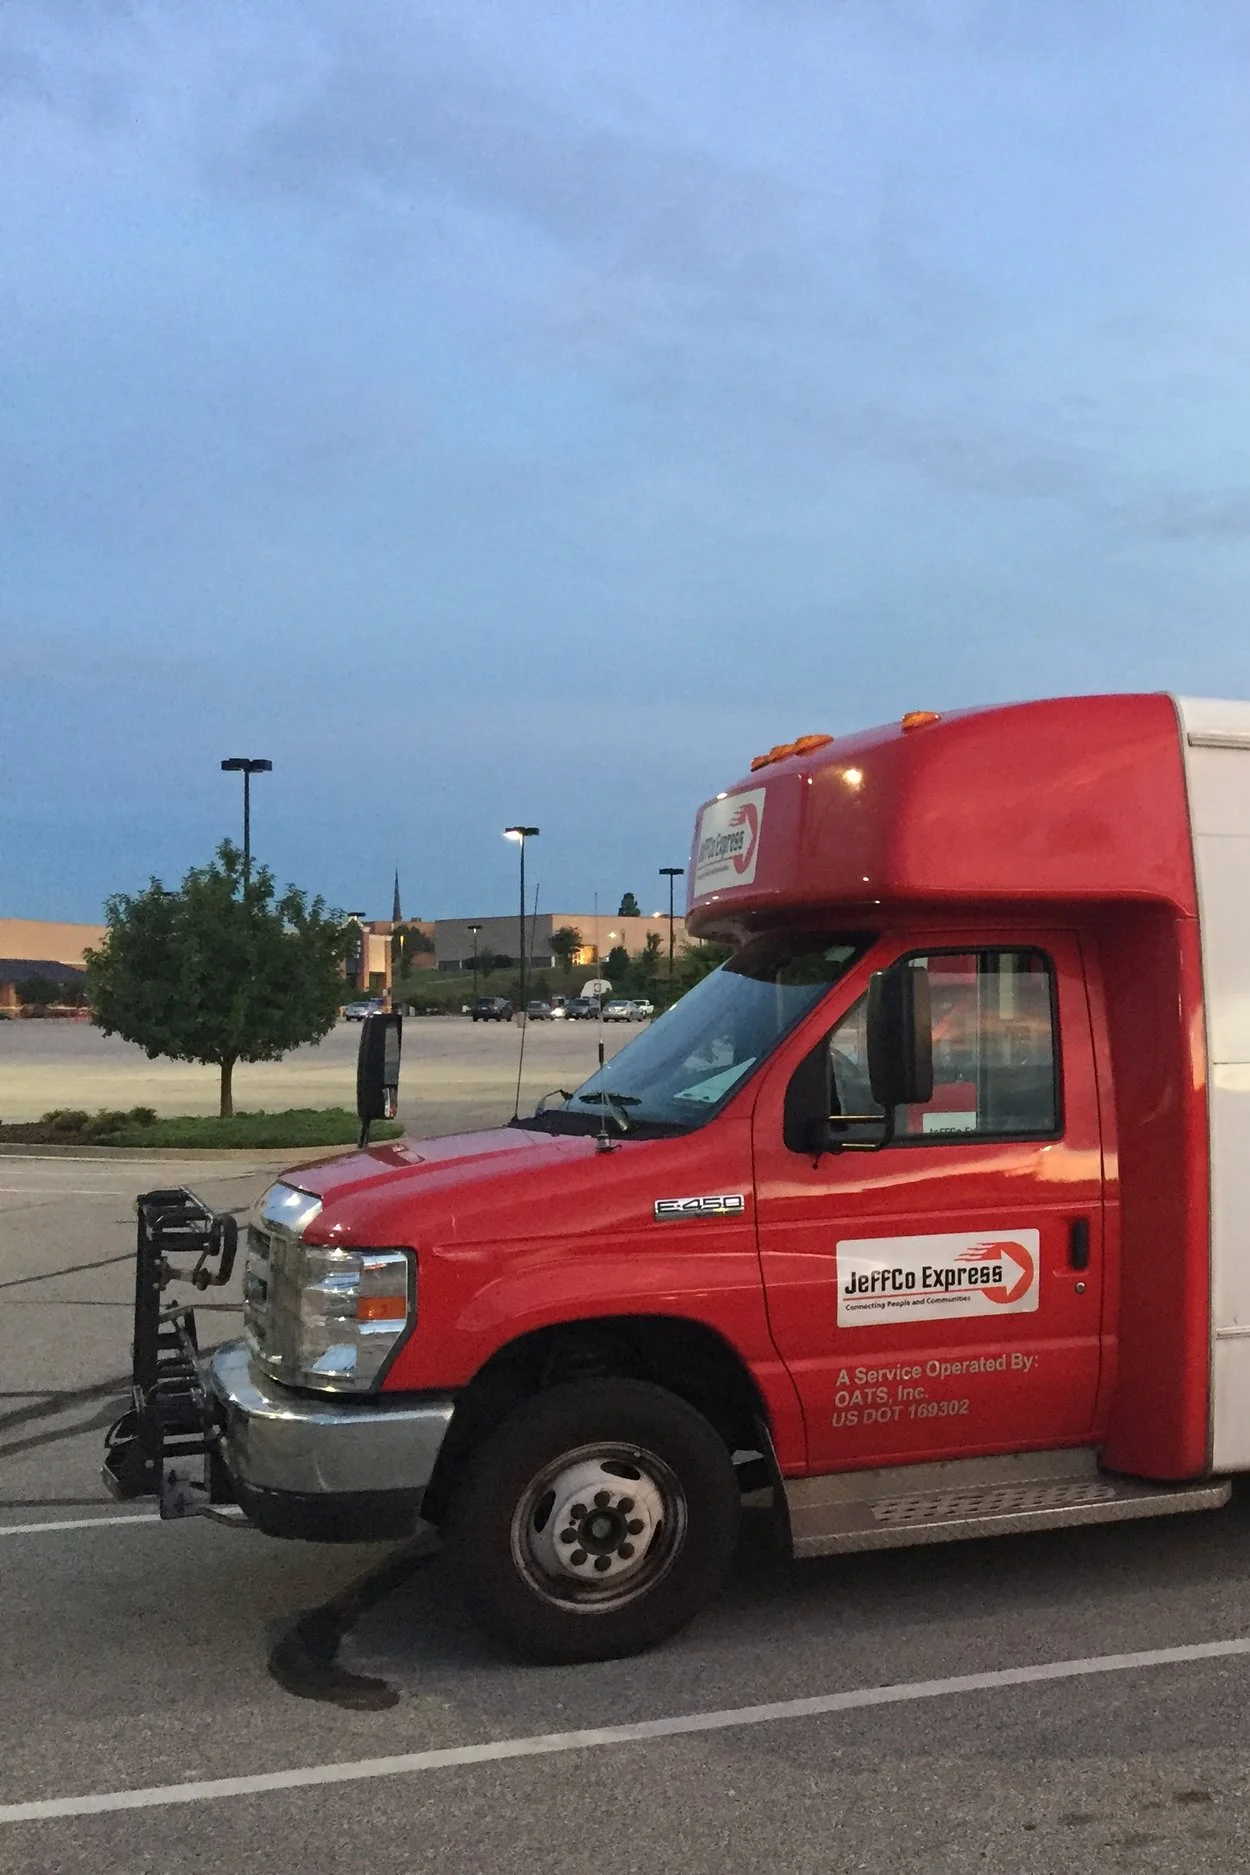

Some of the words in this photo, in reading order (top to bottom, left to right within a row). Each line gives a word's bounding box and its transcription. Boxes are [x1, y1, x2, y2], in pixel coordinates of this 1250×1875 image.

[844, 1269, 916, 1295] JeffCo
[921, 1264, 1003, 1292] Express
[845, 1301, 886, 1311] Connecting
[887, 1299, 911, 1308] People
[911, 1298, 926, 1306] and
[926, 1295, 972, 1304] Communities
[835, 1370, 851, 1387] A
[854, 1364, 922, 1384] Service
[926, 1354, 1007, 1378] Operated
[1010, 1352, 1039, 1373] By:
[835, 1387, 893, 1408] OATS,
[898, 1385, 929, 1402] Inc.
[832, 1410, 859, 1428] US
[863, 1405, 905, 1425] DOT
[908, 1399, 970, 1420] 169302
